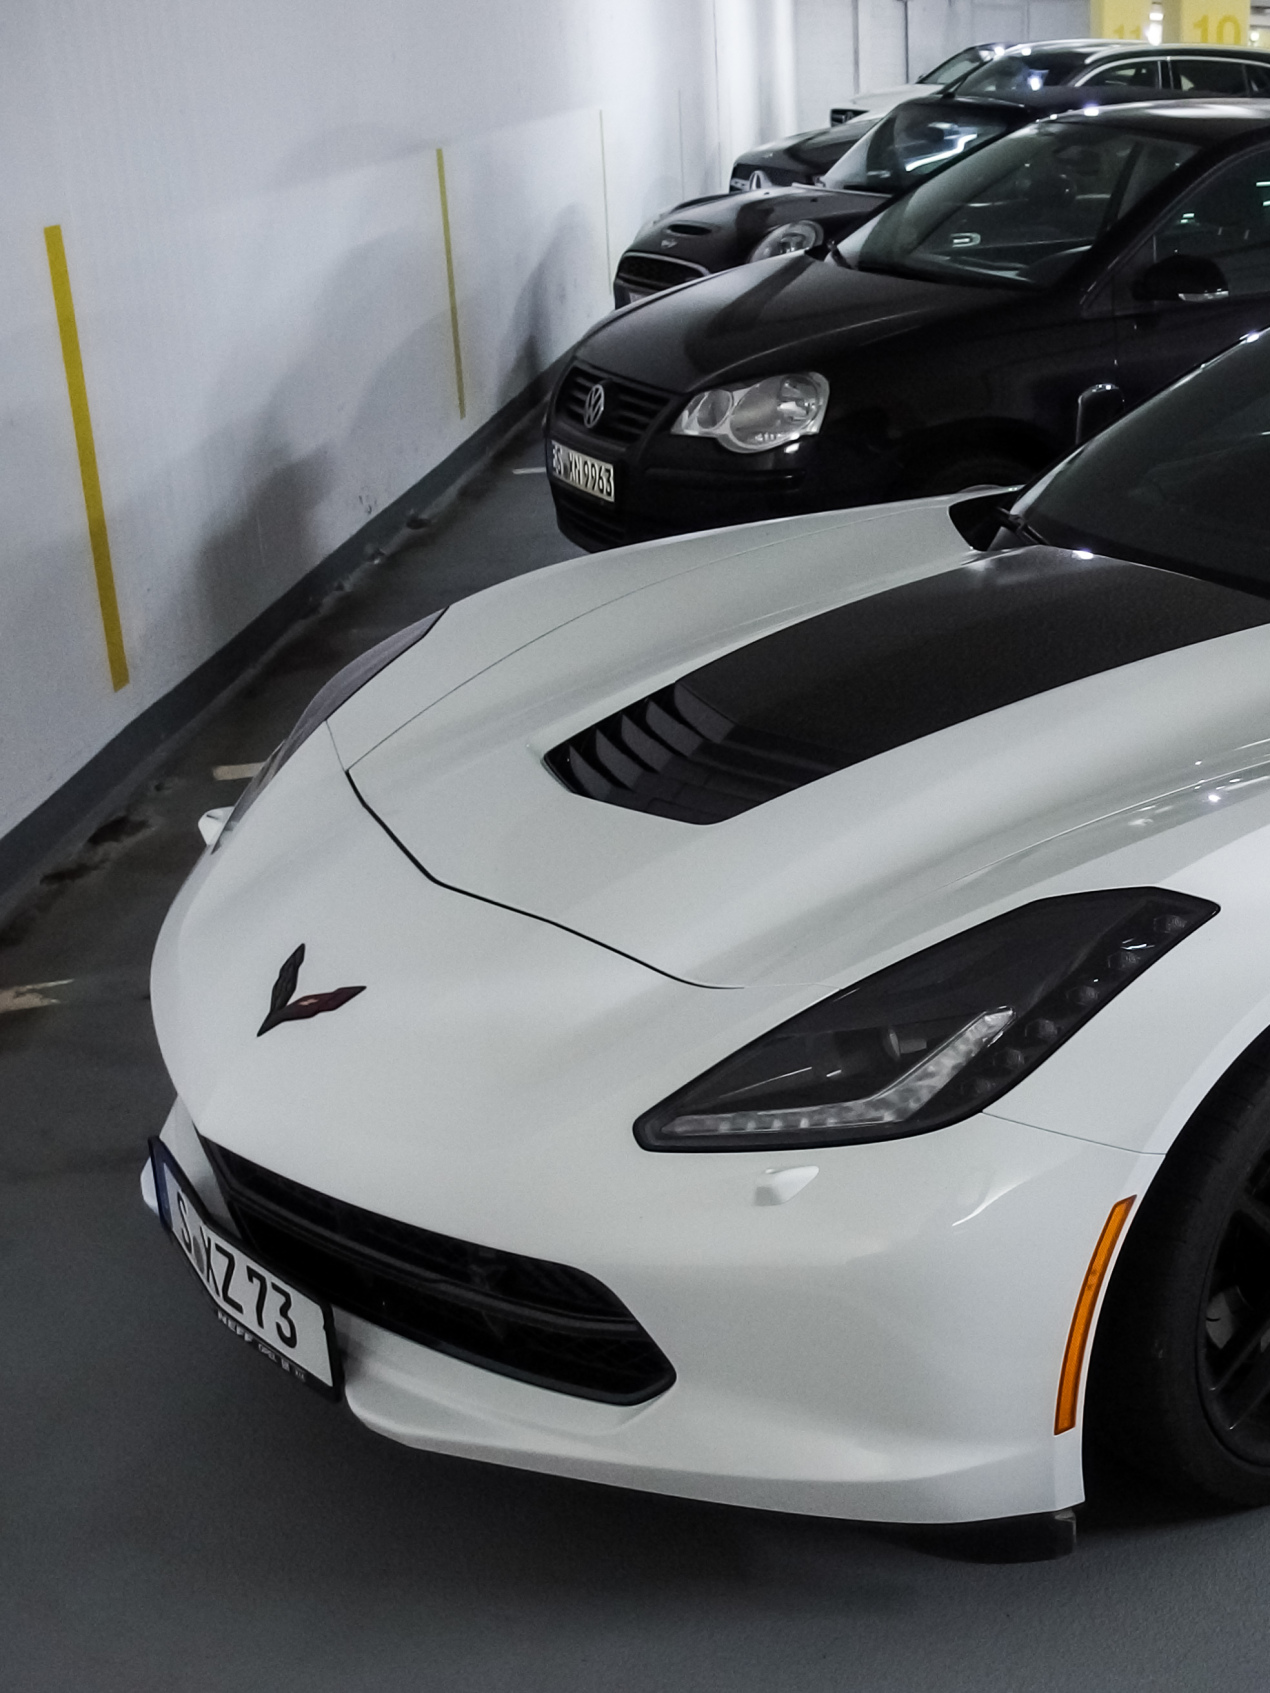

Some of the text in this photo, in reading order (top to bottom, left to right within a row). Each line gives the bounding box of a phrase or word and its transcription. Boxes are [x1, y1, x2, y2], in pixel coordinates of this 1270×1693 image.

[1192, 14, 1241, 44] 10
[583, 459, 613, 498] 9963
[176, 1190, 298, 1349] S XZ 73
